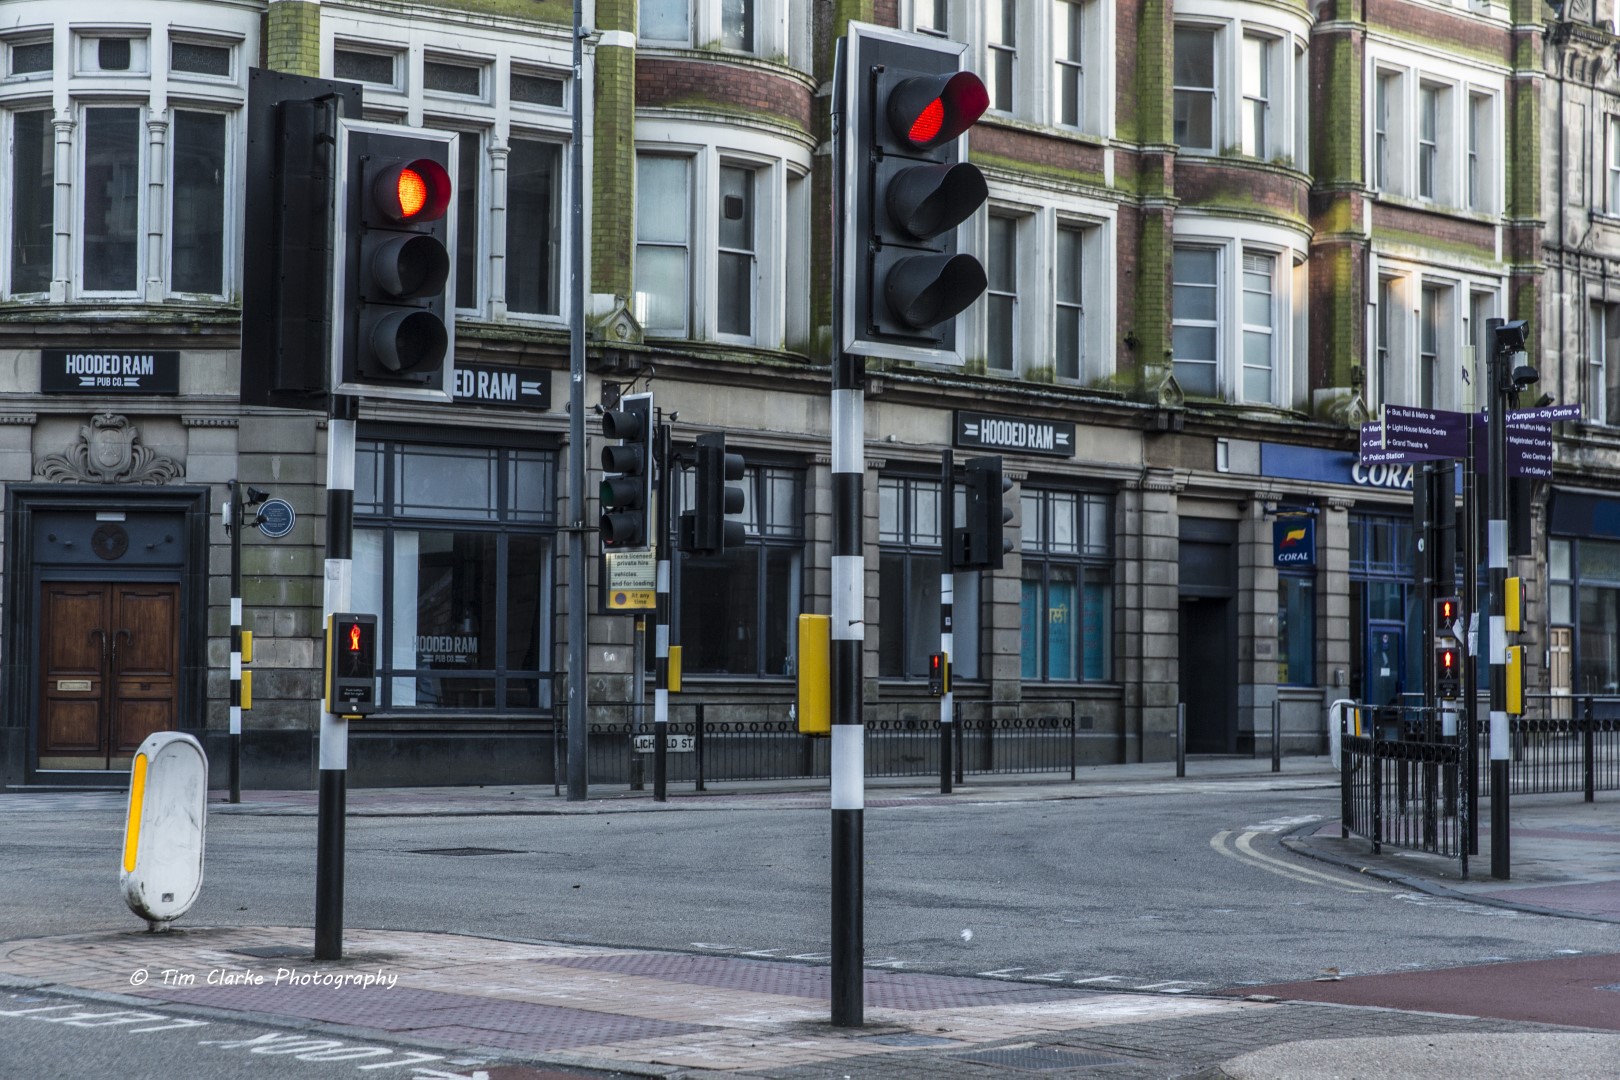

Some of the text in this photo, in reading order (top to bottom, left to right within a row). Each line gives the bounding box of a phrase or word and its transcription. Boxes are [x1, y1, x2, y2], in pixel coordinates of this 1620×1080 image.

[66, 354, 153, 375] HOODED RAM
[97, 377, 124, 387] PUB CO.
[453, 369, 516, 400] ED RAM
[1512, 412, 1535, 420] Campus
[1540, 410, 1552, 418] City
[1553, 409, 1572, 417] Centre
[981, 419, 1053, 450] HOODED RAM
[1536, 424, 1546, 432] Halls
[1392, 439, 1423, 449] Grand Theatre
[1352, 461, 1413, 488] CORA
[1532, 467, 1546, 476] Gallery
[1278, 552, 1308, 561] CORAL
[412, 636, 478, 653] HOODED RAM
[635, 738, 677, 749] LICHLD
[977, 967, 1208, 989] LEFT
[0, 1004, 445, 1070] LOOK LEFT
